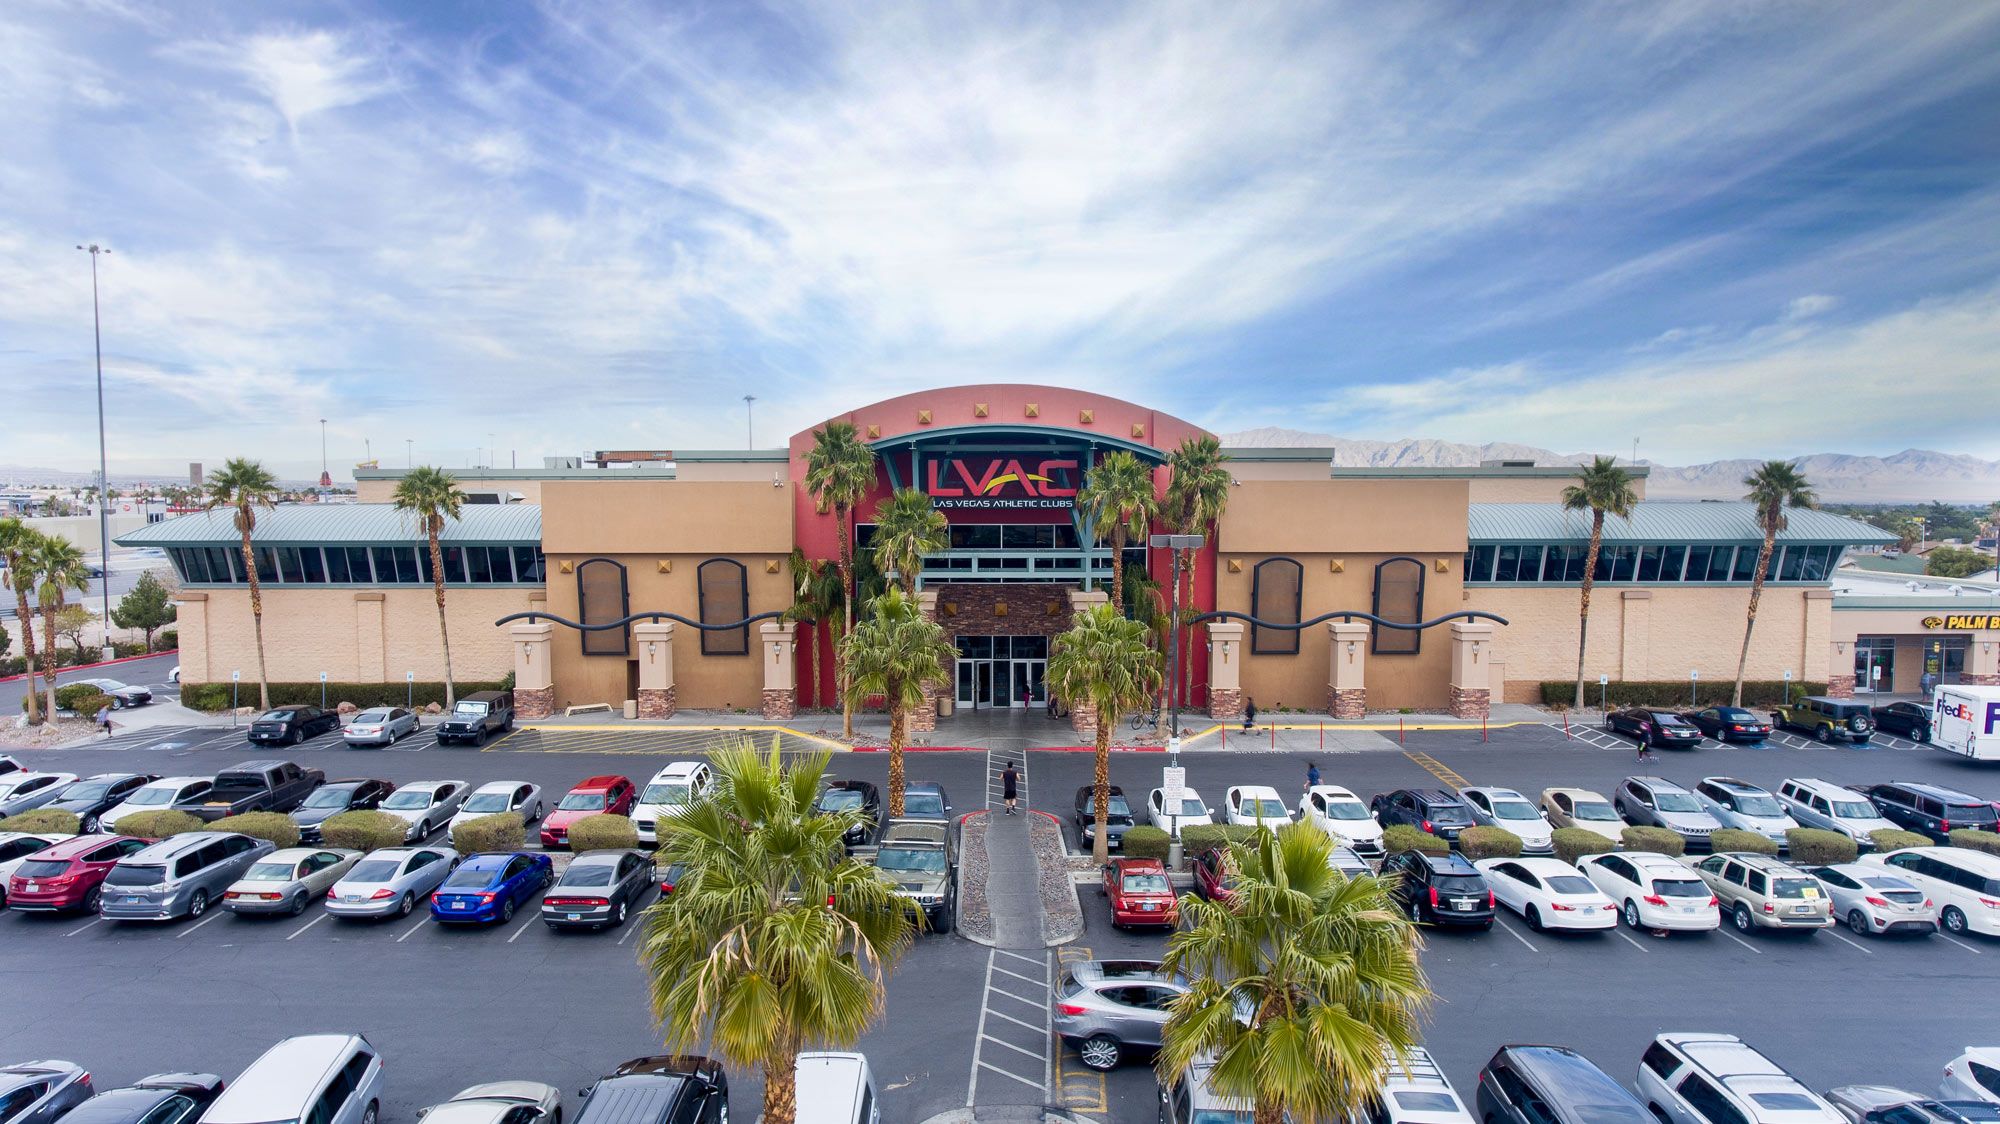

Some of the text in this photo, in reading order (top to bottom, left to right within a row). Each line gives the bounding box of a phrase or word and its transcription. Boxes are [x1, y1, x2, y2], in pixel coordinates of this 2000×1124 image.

[927, 459, 1078, 497] LVAC
[933, 500, 1073, 508] LAS VEGAS ATHLETIC CLUBS
[1946, 615, 1987, 629] PALM
[1936, 698, 1974, 723] FedEx
